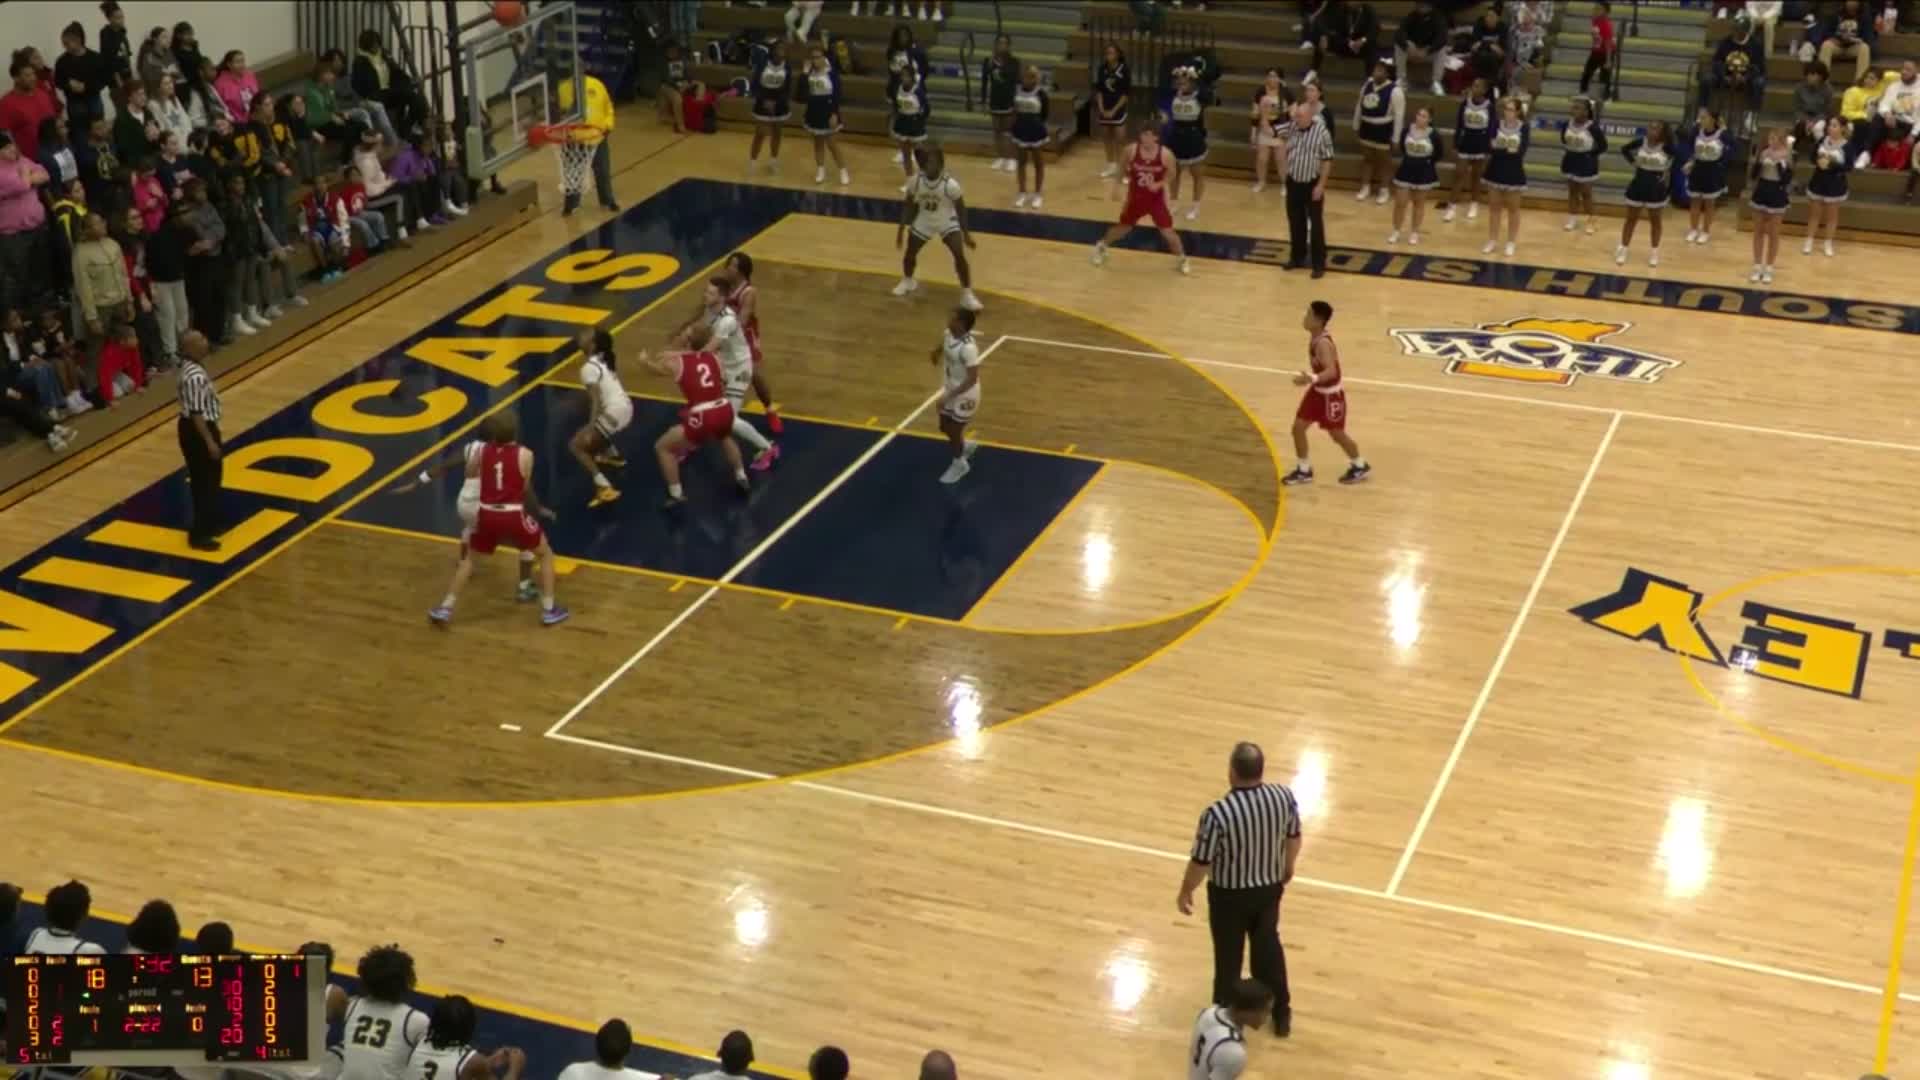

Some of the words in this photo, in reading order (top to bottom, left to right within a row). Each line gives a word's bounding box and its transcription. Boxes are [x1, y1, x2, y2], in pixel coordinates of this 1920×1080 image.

[1243, 241, 1481, 282] SIDE
[1524, 268, 1906, 329] SOUTH
[696, 363, 714, 388] 2
[494, 461, 504, 491] 1
[28, 968, 39, 983] 0
[87, 968, 105, 989] 18
[193, 967, 212, 987] 13
[264, 964, 275, 979] 0
[28, 984, 39, 998] 0
[264, 980, 276, 995] 2
[265, 996, 276, 1011] 0
[29, 1015, 39, 1030] 0
[192, 1016, 203, 1032] 0
[265, 1012, 276, 1027] 0
[30, 1031, 40, 1046] 3
[221, 1028, 243, 1044] 20
[266, 1028, 276, 1043] 5
[351, 1015, 392, 1049] 23
[19, 1047, 30, 1063] 5
[255, 1046, 267, 1059] 4
